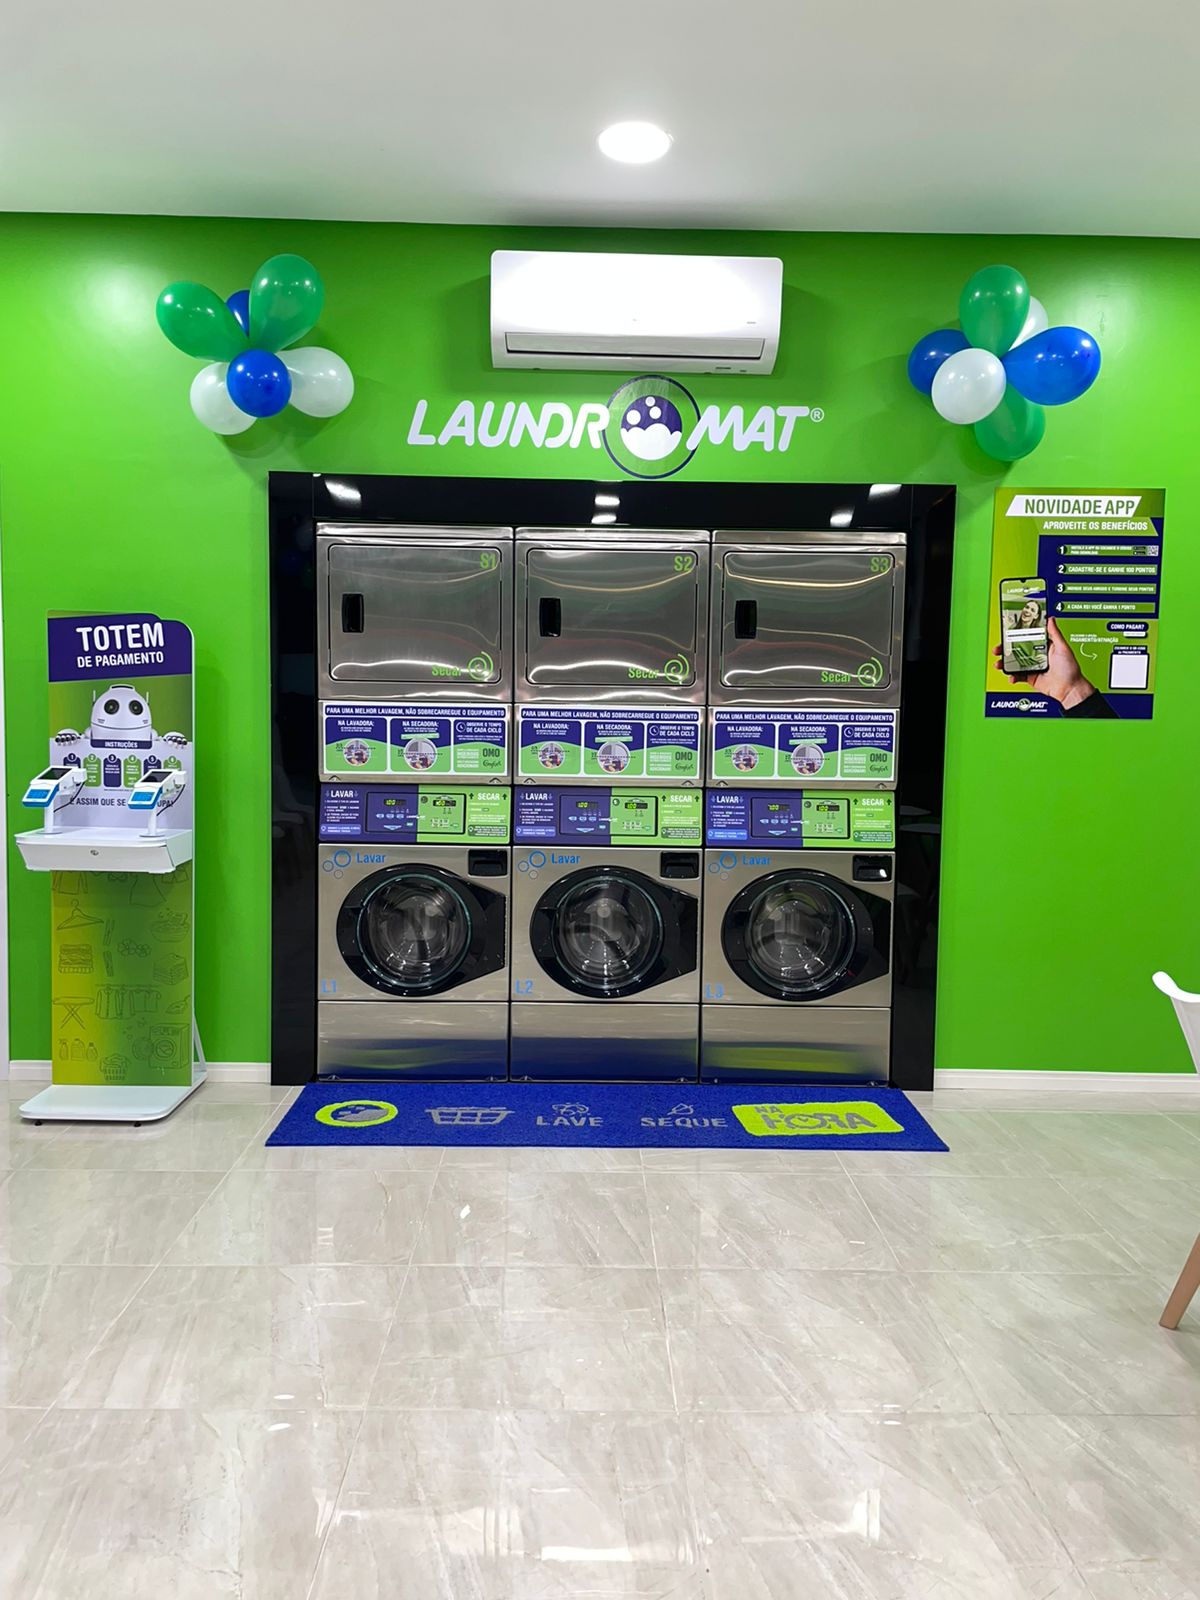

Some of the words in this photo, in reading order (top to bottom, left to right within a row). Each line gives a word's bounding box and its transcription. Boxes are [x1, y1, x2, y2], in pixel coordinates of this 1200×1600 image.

[1025, 498, 1102, 514] NOVIDADE
[1104, 500, 1134, 514] APP
[1043, 520, 1086, 530] APROVEITE
[1088, 521, 1100, 530] OS
[1102, 520, 1148, 530] BENEFÍCIOS
[1060, 546, 1064, 554] 1
[480, 553, 496, 569] S1
[674, 555, 693, 571] S2
[870, 557, 889, 572] S3
[1058, 564, 1064, 573] 2
[1057, 584, 1063, 592] 3
[1056, 603, 1062, 611] 4
[76, 622, 164, 652] TOTEM
[77, 656, 92, 668] DE
[95, 651, 164, 667] PAGAMENTO
[432, 664, 462, 676] Secar
[628, 667, 659, 679] Secar
[821, 671, 850, 682] Secar
[104, 740, 138, 749] INSTRUÇÕES
[482, 748, 500, 757] OMO
[675, 752, 692, 760] OMO
[870, 753, 887, 762] OMO
[76, 798, 99, 806] ASSIM
[356, 852, 386, 864] Lavar
[551, 853, 581, 864] Lavar
[742, 854, 772, 865] Lavar
[321, 980, 337, 993] L1
[515, 980, 533, 994] L2
[705, 984, 725, 999] L3
[754, 1105, 783, 1114] NA
[536, 1116, 604, 1127] LAVE
[640, 1116, 728, 1128] SEQUE
